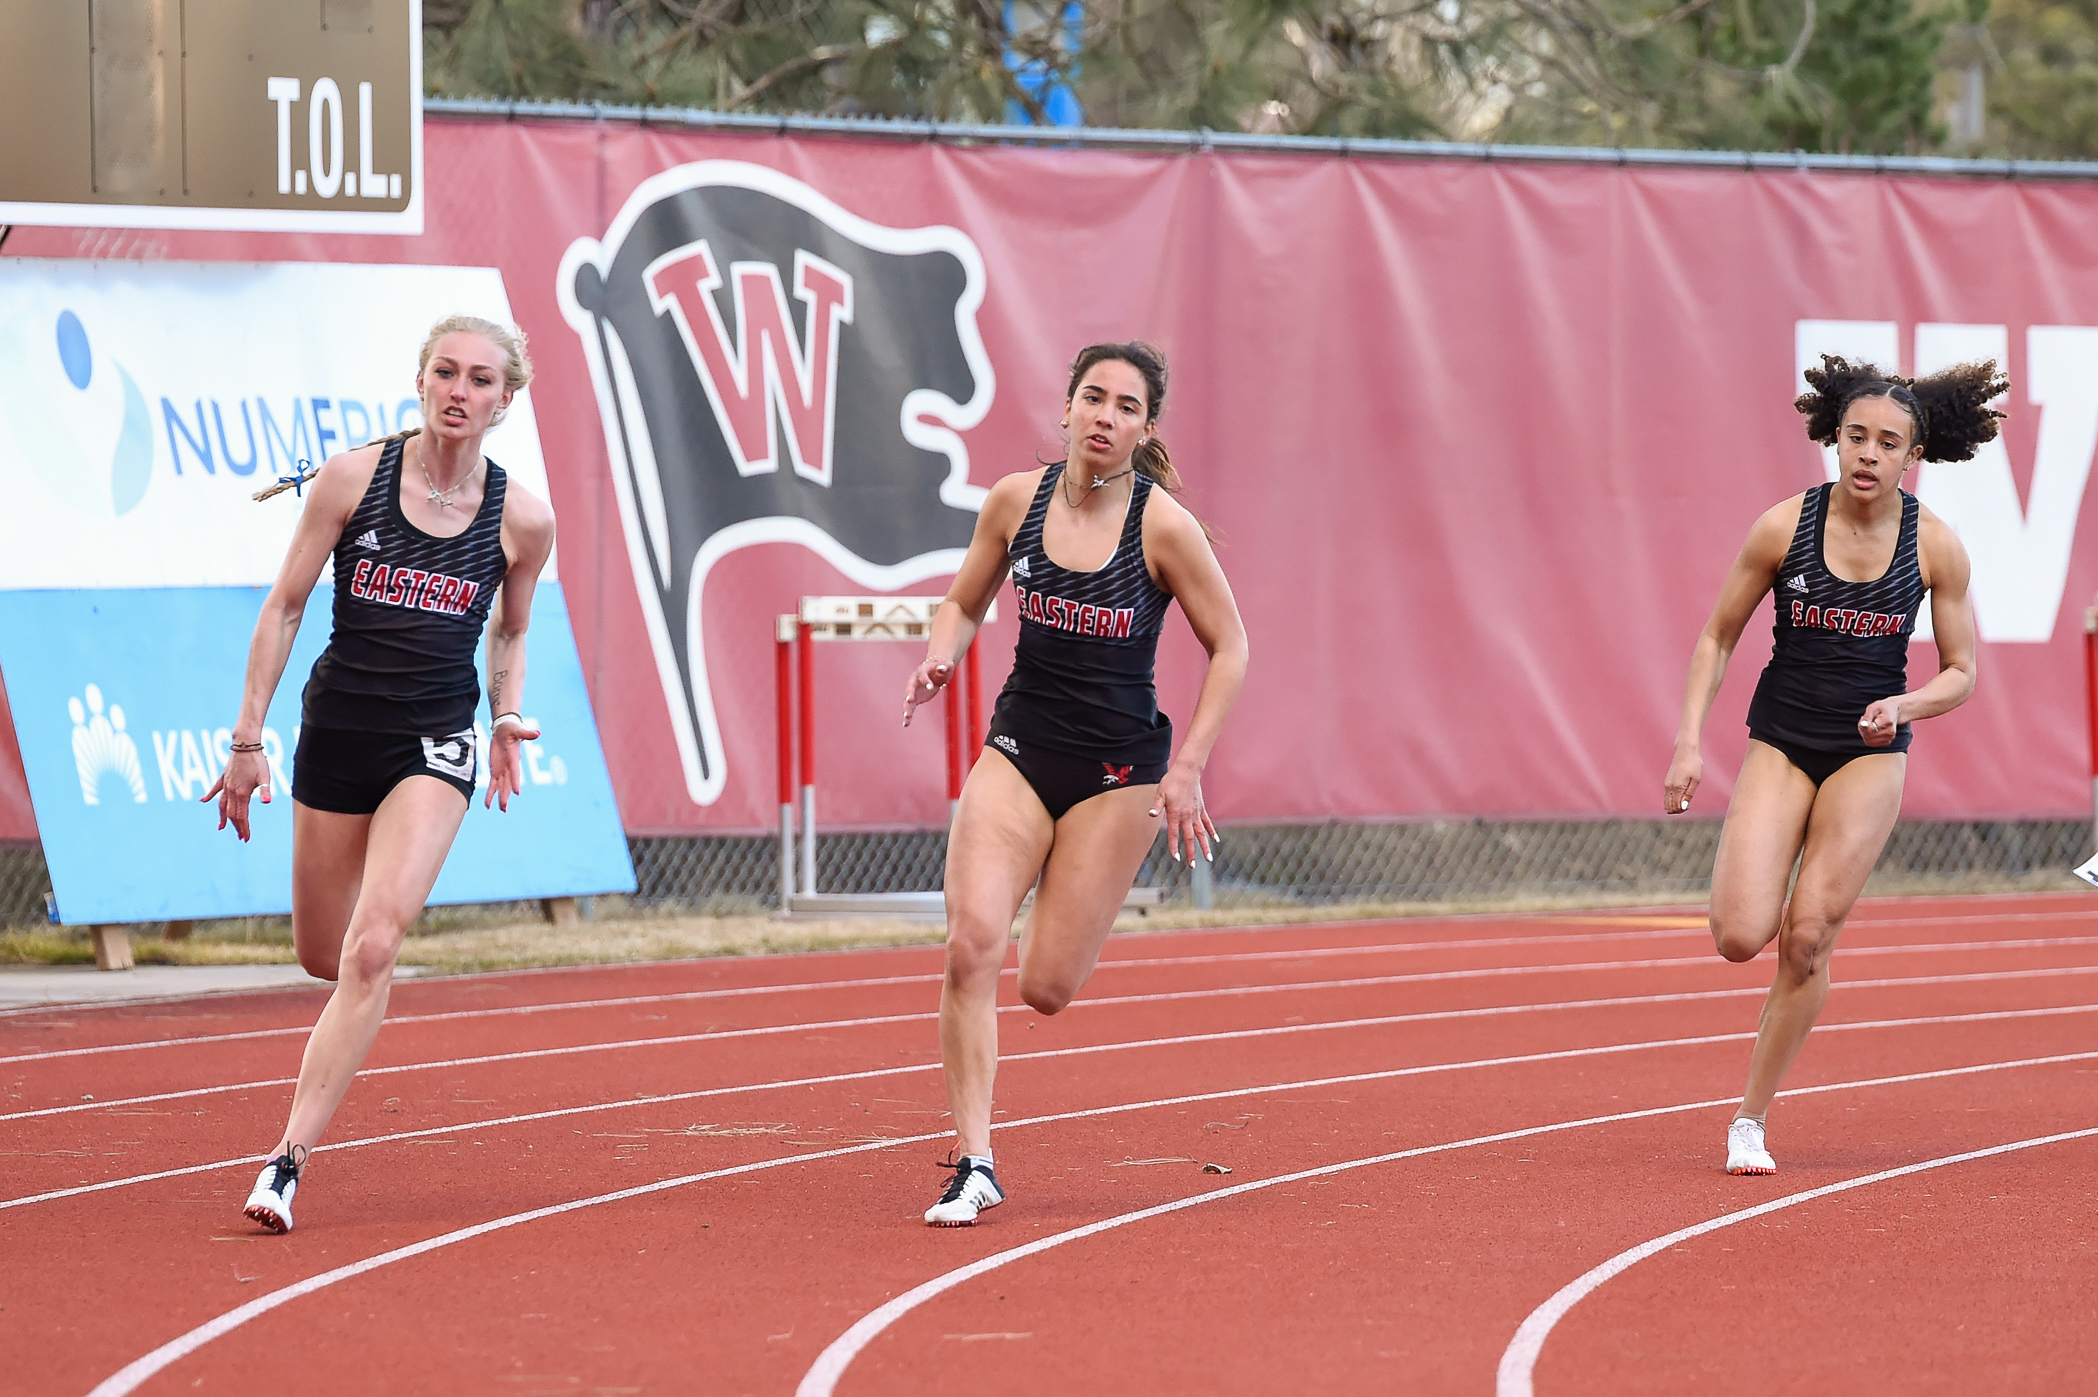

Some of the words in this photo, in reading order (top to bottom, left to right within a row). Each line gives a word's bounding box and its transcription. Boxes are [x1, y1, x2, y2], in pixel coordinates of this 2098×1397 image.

[267, 76, 402, 199] T.O.L.
[641, 238, 854, 488] W
[354, 538, 381, 551] adidas
[351, 558, 480, 615] EASTERN
[1013, 565, 1032, 579] adidas
[1786, 581, 1810, 594] adidas
[1016, 585, 1135, 638] EASTERN
[1791, 600, 1907, 638] EASTERN
[151, 726, 292, 802] KAISR
[993, 736, 1020, 755] adidas
